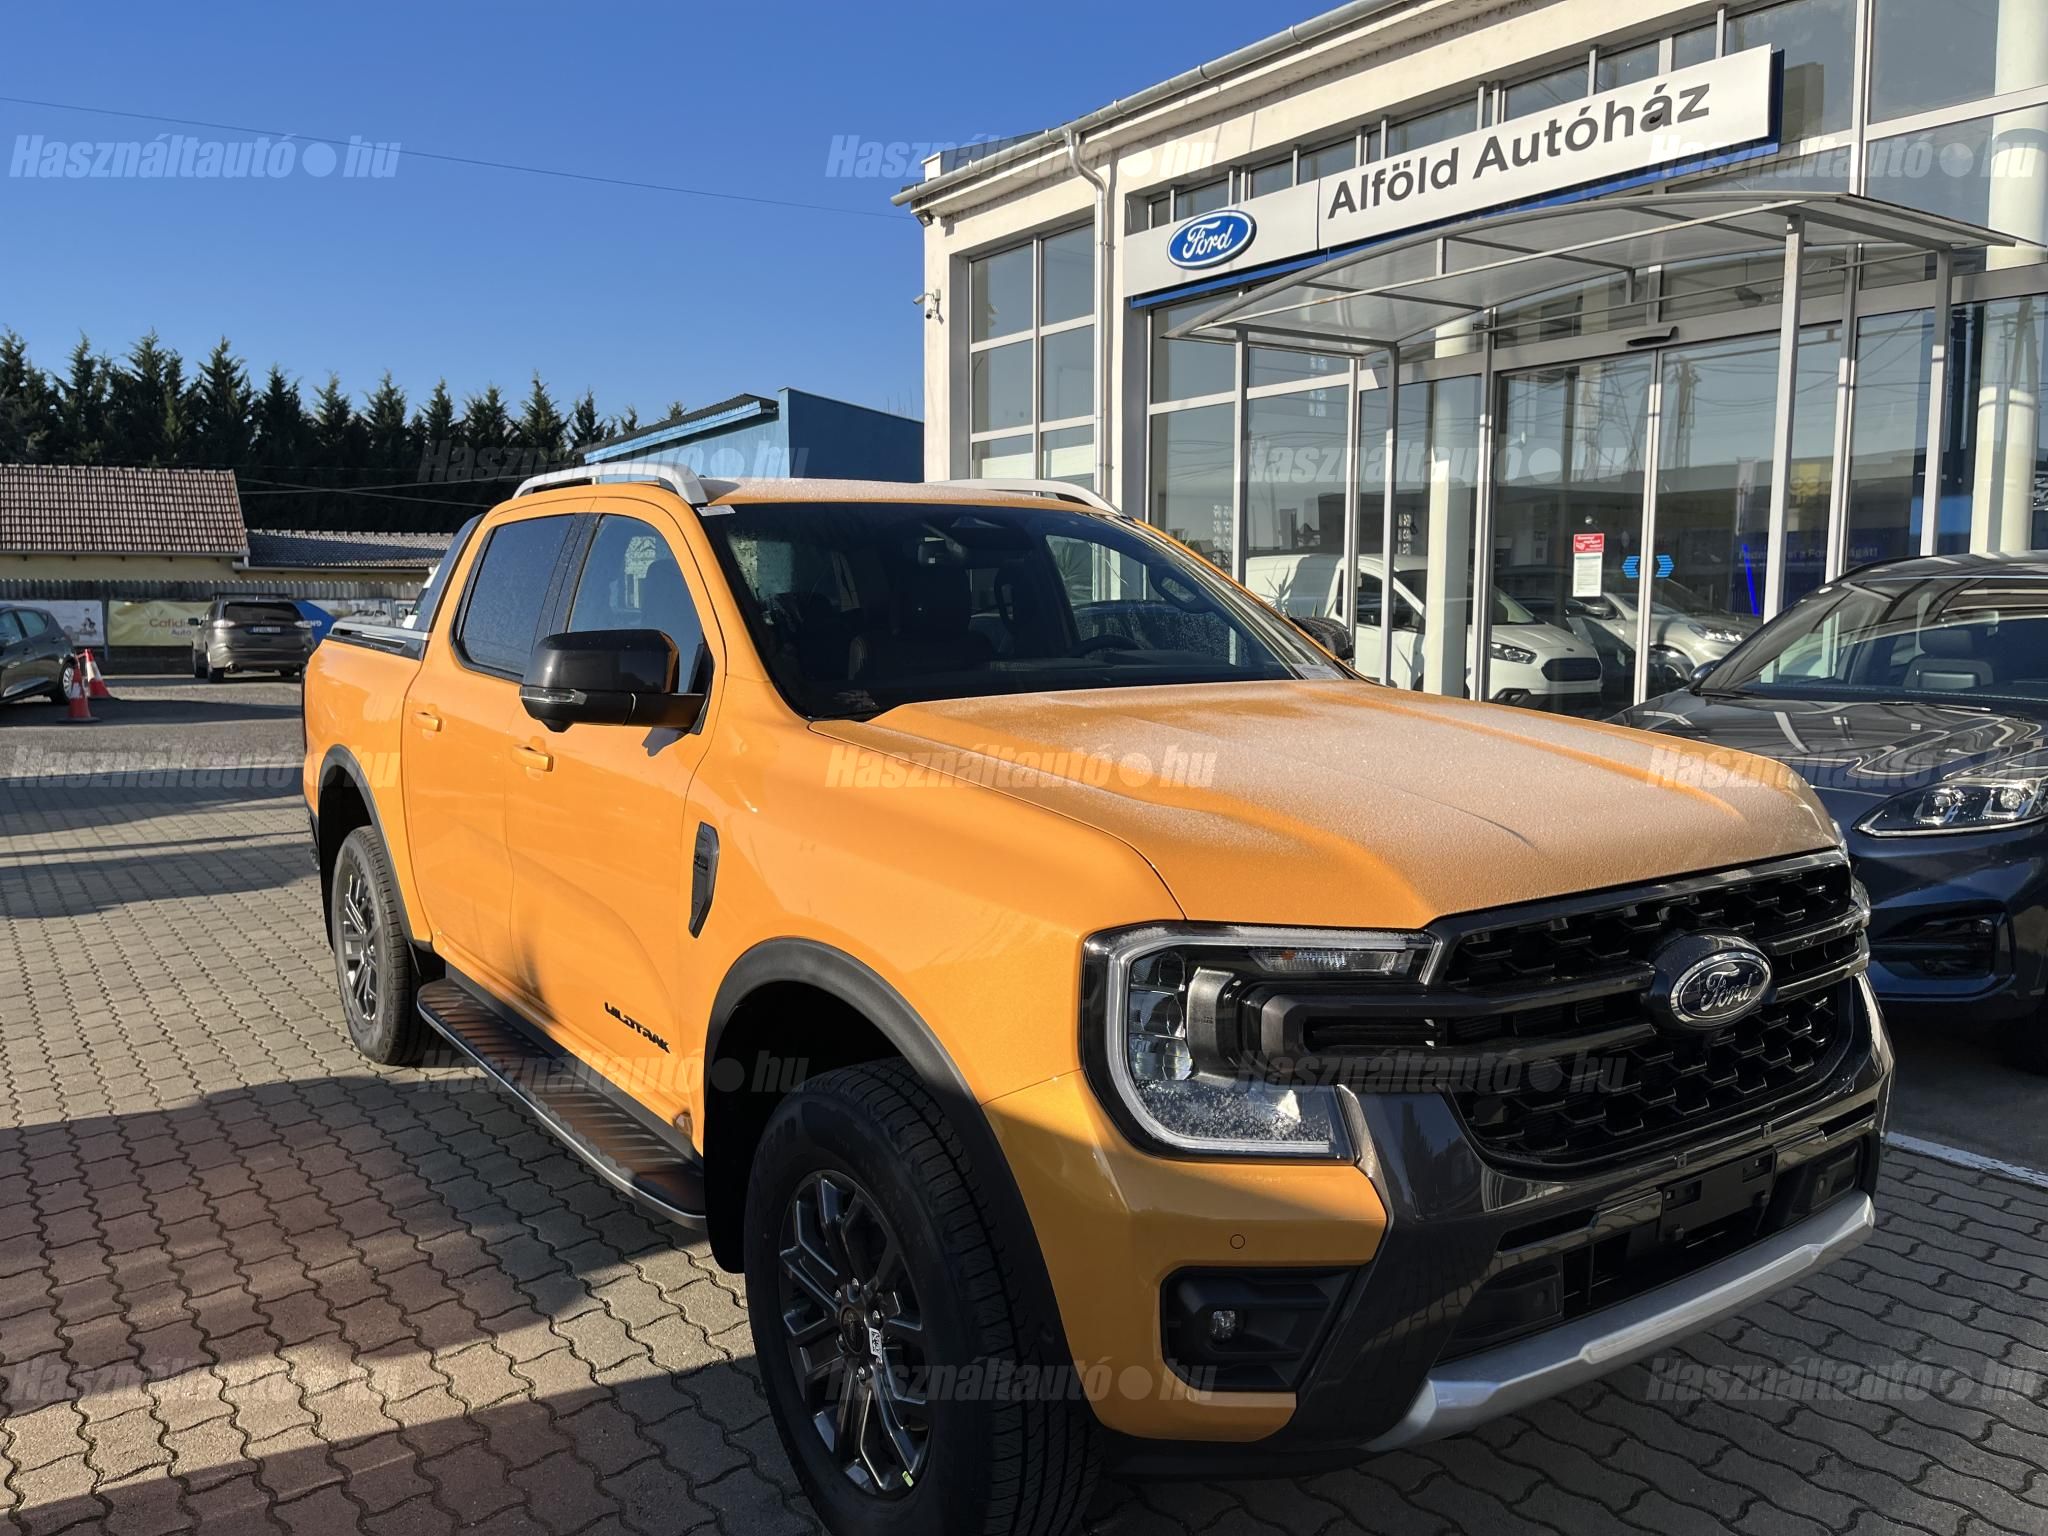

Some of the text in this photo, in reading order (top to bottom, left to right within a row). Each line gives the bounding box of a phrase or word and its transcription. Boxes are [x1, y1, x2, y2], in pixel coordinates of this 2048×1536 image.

[1328, 83, 1710, 220] Alföld Autóház
[1183, 220, 1234, 259] Ford
[1700, 966, 1753, 1012] Ford
